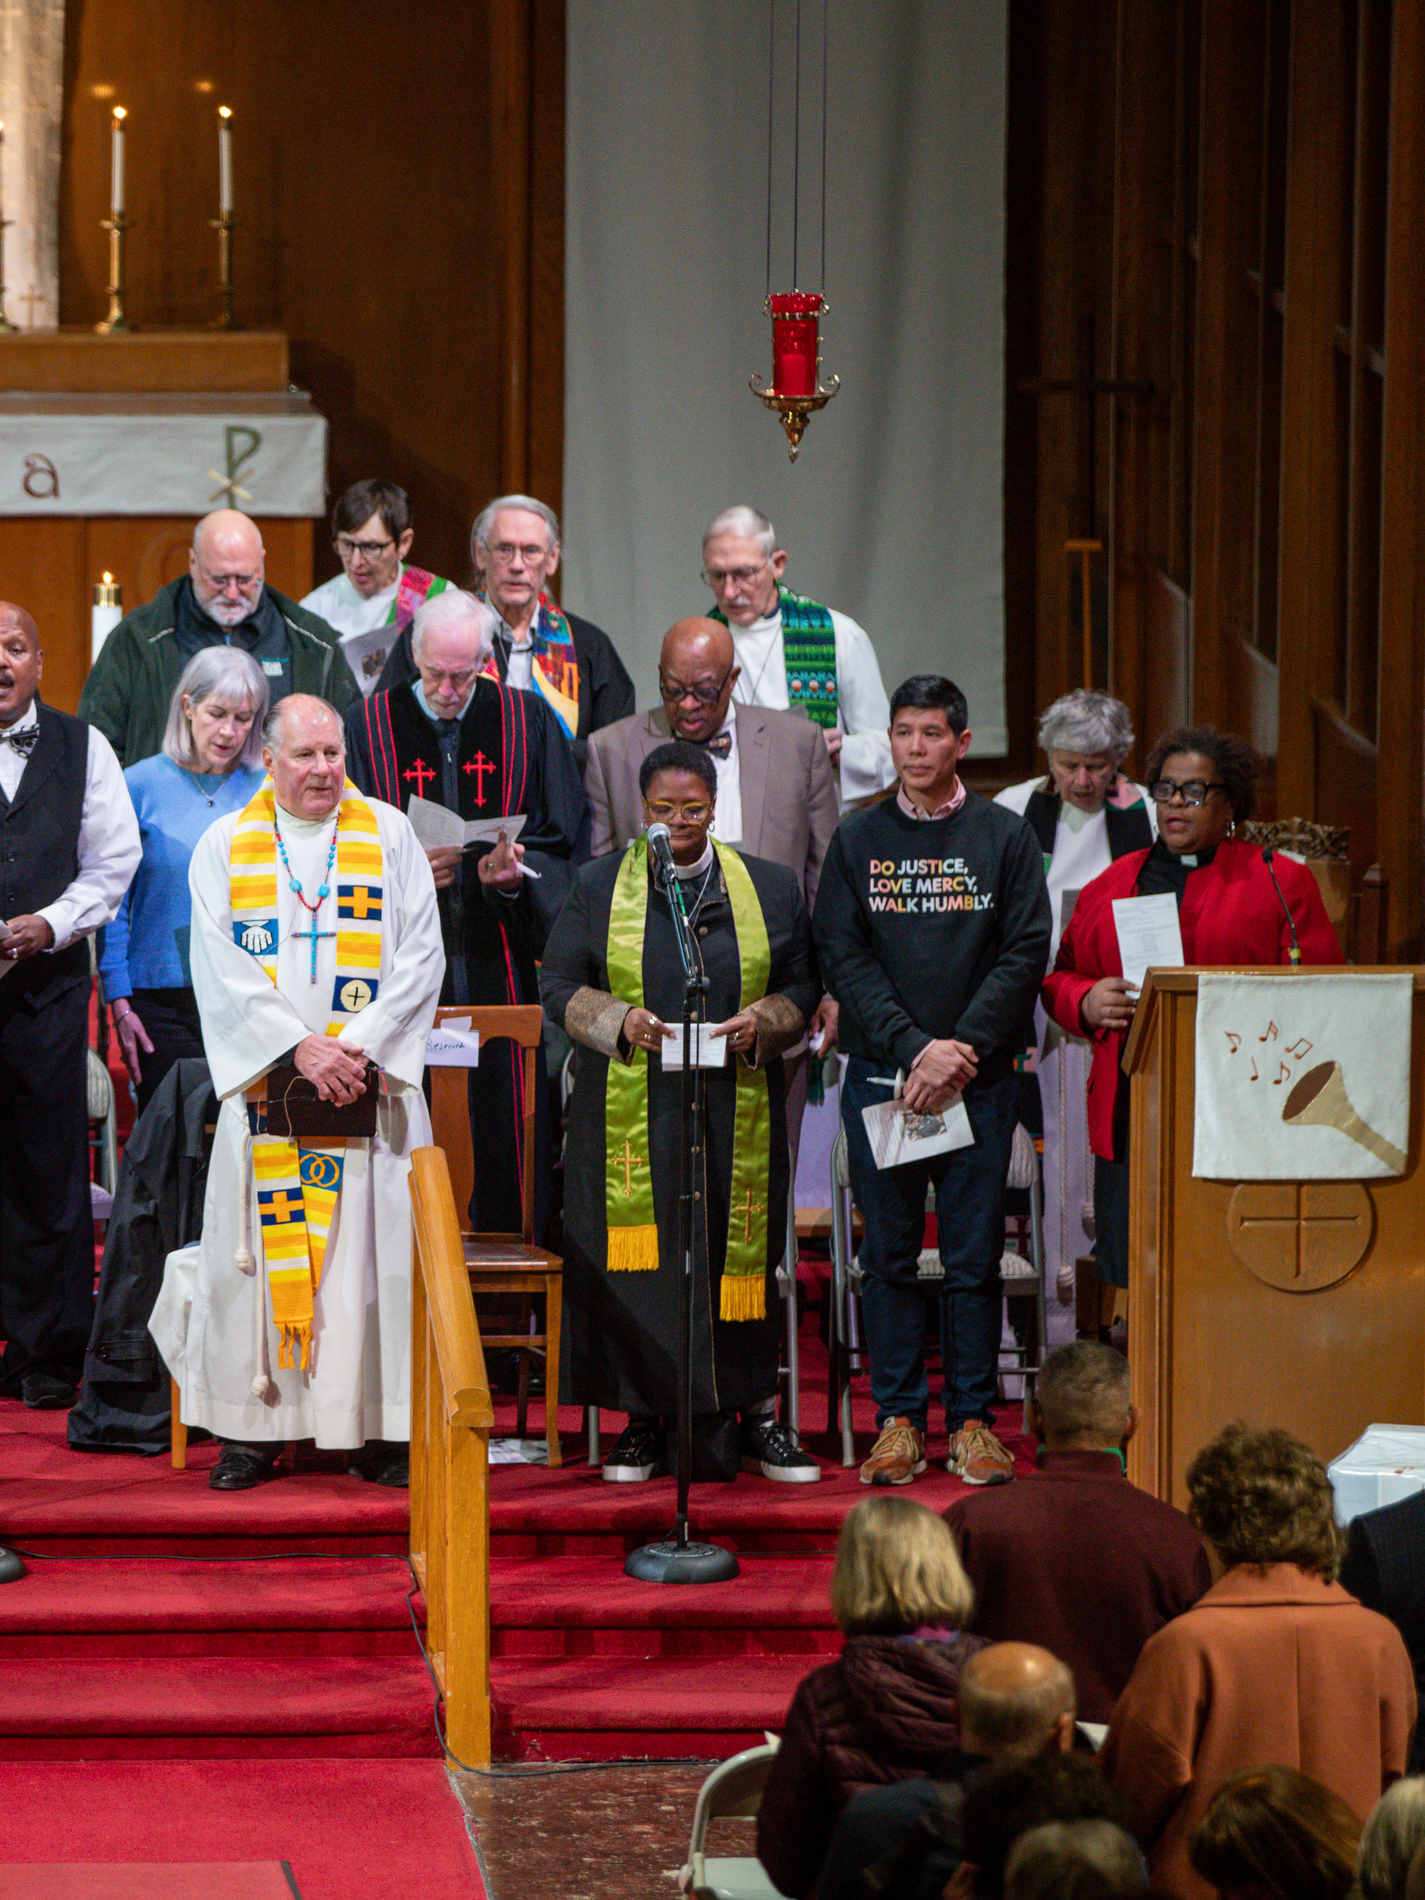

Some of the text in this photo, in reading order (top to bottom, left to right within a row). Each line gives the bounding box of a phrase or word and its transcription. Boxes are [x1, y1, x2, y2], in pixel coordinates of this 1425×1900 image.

[869, 858, 969, 876] DO JUSTICE,
[869, 876, 978, 894] LOVE MERCY,
[868, 893, 995, 913] WALK HUMBLY.
